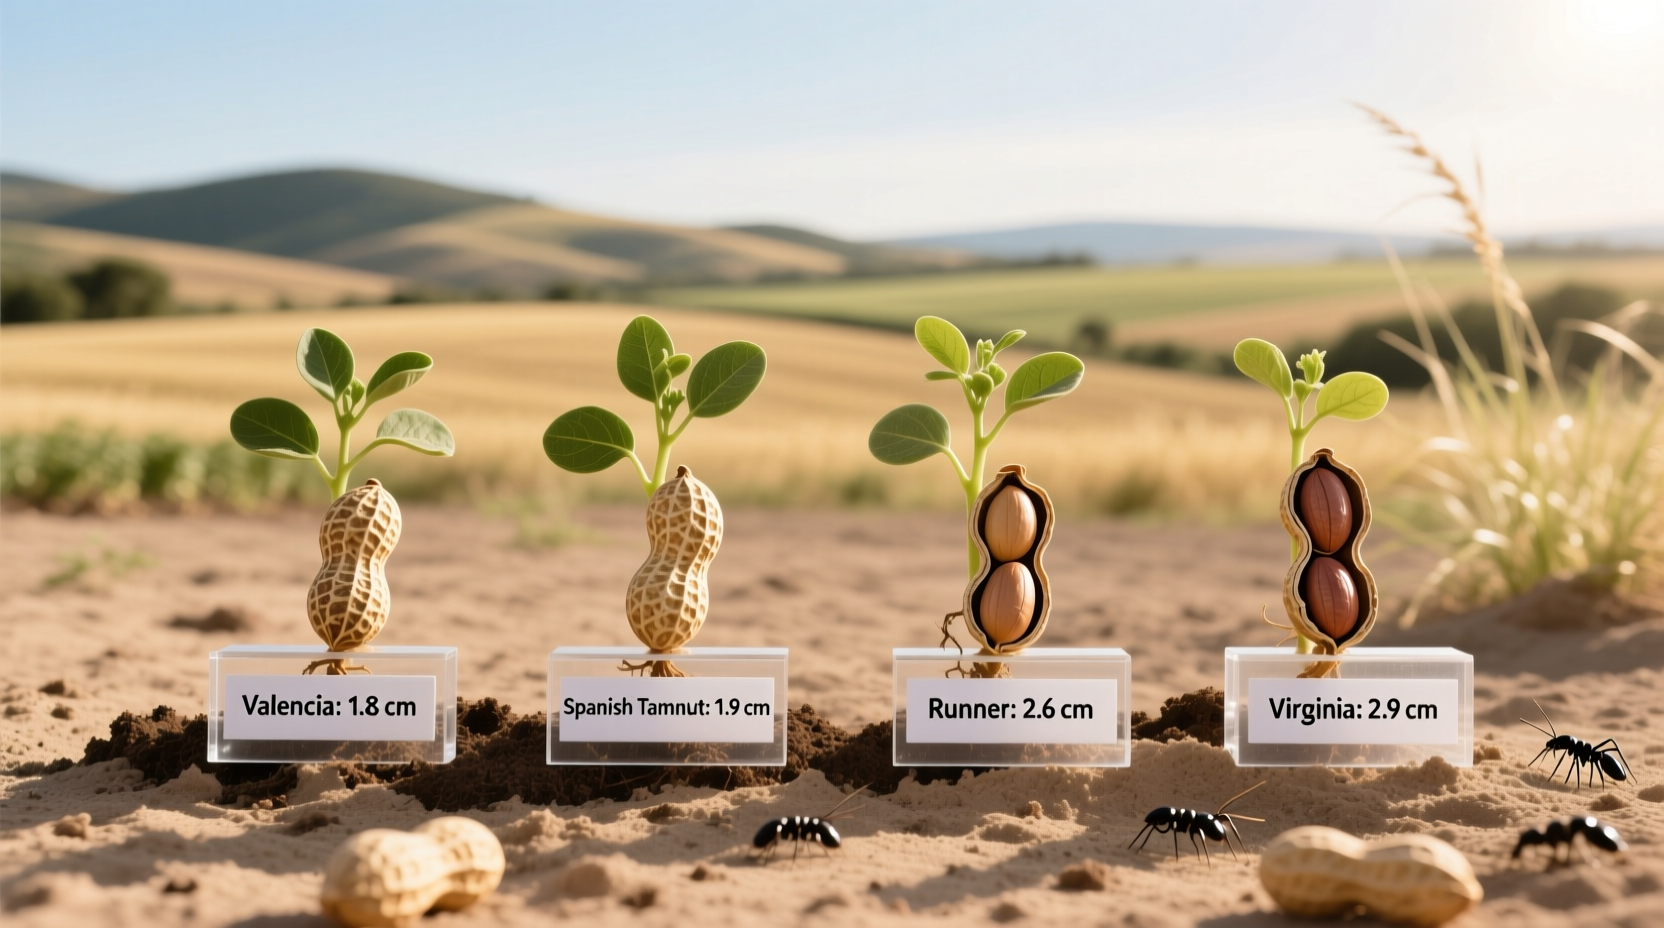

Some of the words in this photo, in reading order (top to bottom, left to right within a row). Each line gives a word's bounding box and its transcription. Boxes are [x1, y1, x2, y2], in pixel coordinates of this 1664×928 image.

[242, 694, 341, 716] Valencia:
[348, 695, 379, 716] 1.8
[384, 700, 416, 716] cm
[563, 697, 633, 720] Spanish
[637, 697, 710, 716] Tamnut:
[714, 697, 740, 716] 1.9
[743, 702, 770, 716] cm
[928, 697, 1016, 719] Runner:
[1022, 697, 1056, 719] 2.6
[1060, 703, 1093, 719] cm
[1268, 696, 1362, 726] Virginia:
[1368, 697, 1401, 719] 2.9
[1405, 703, 1438, 719] cm
